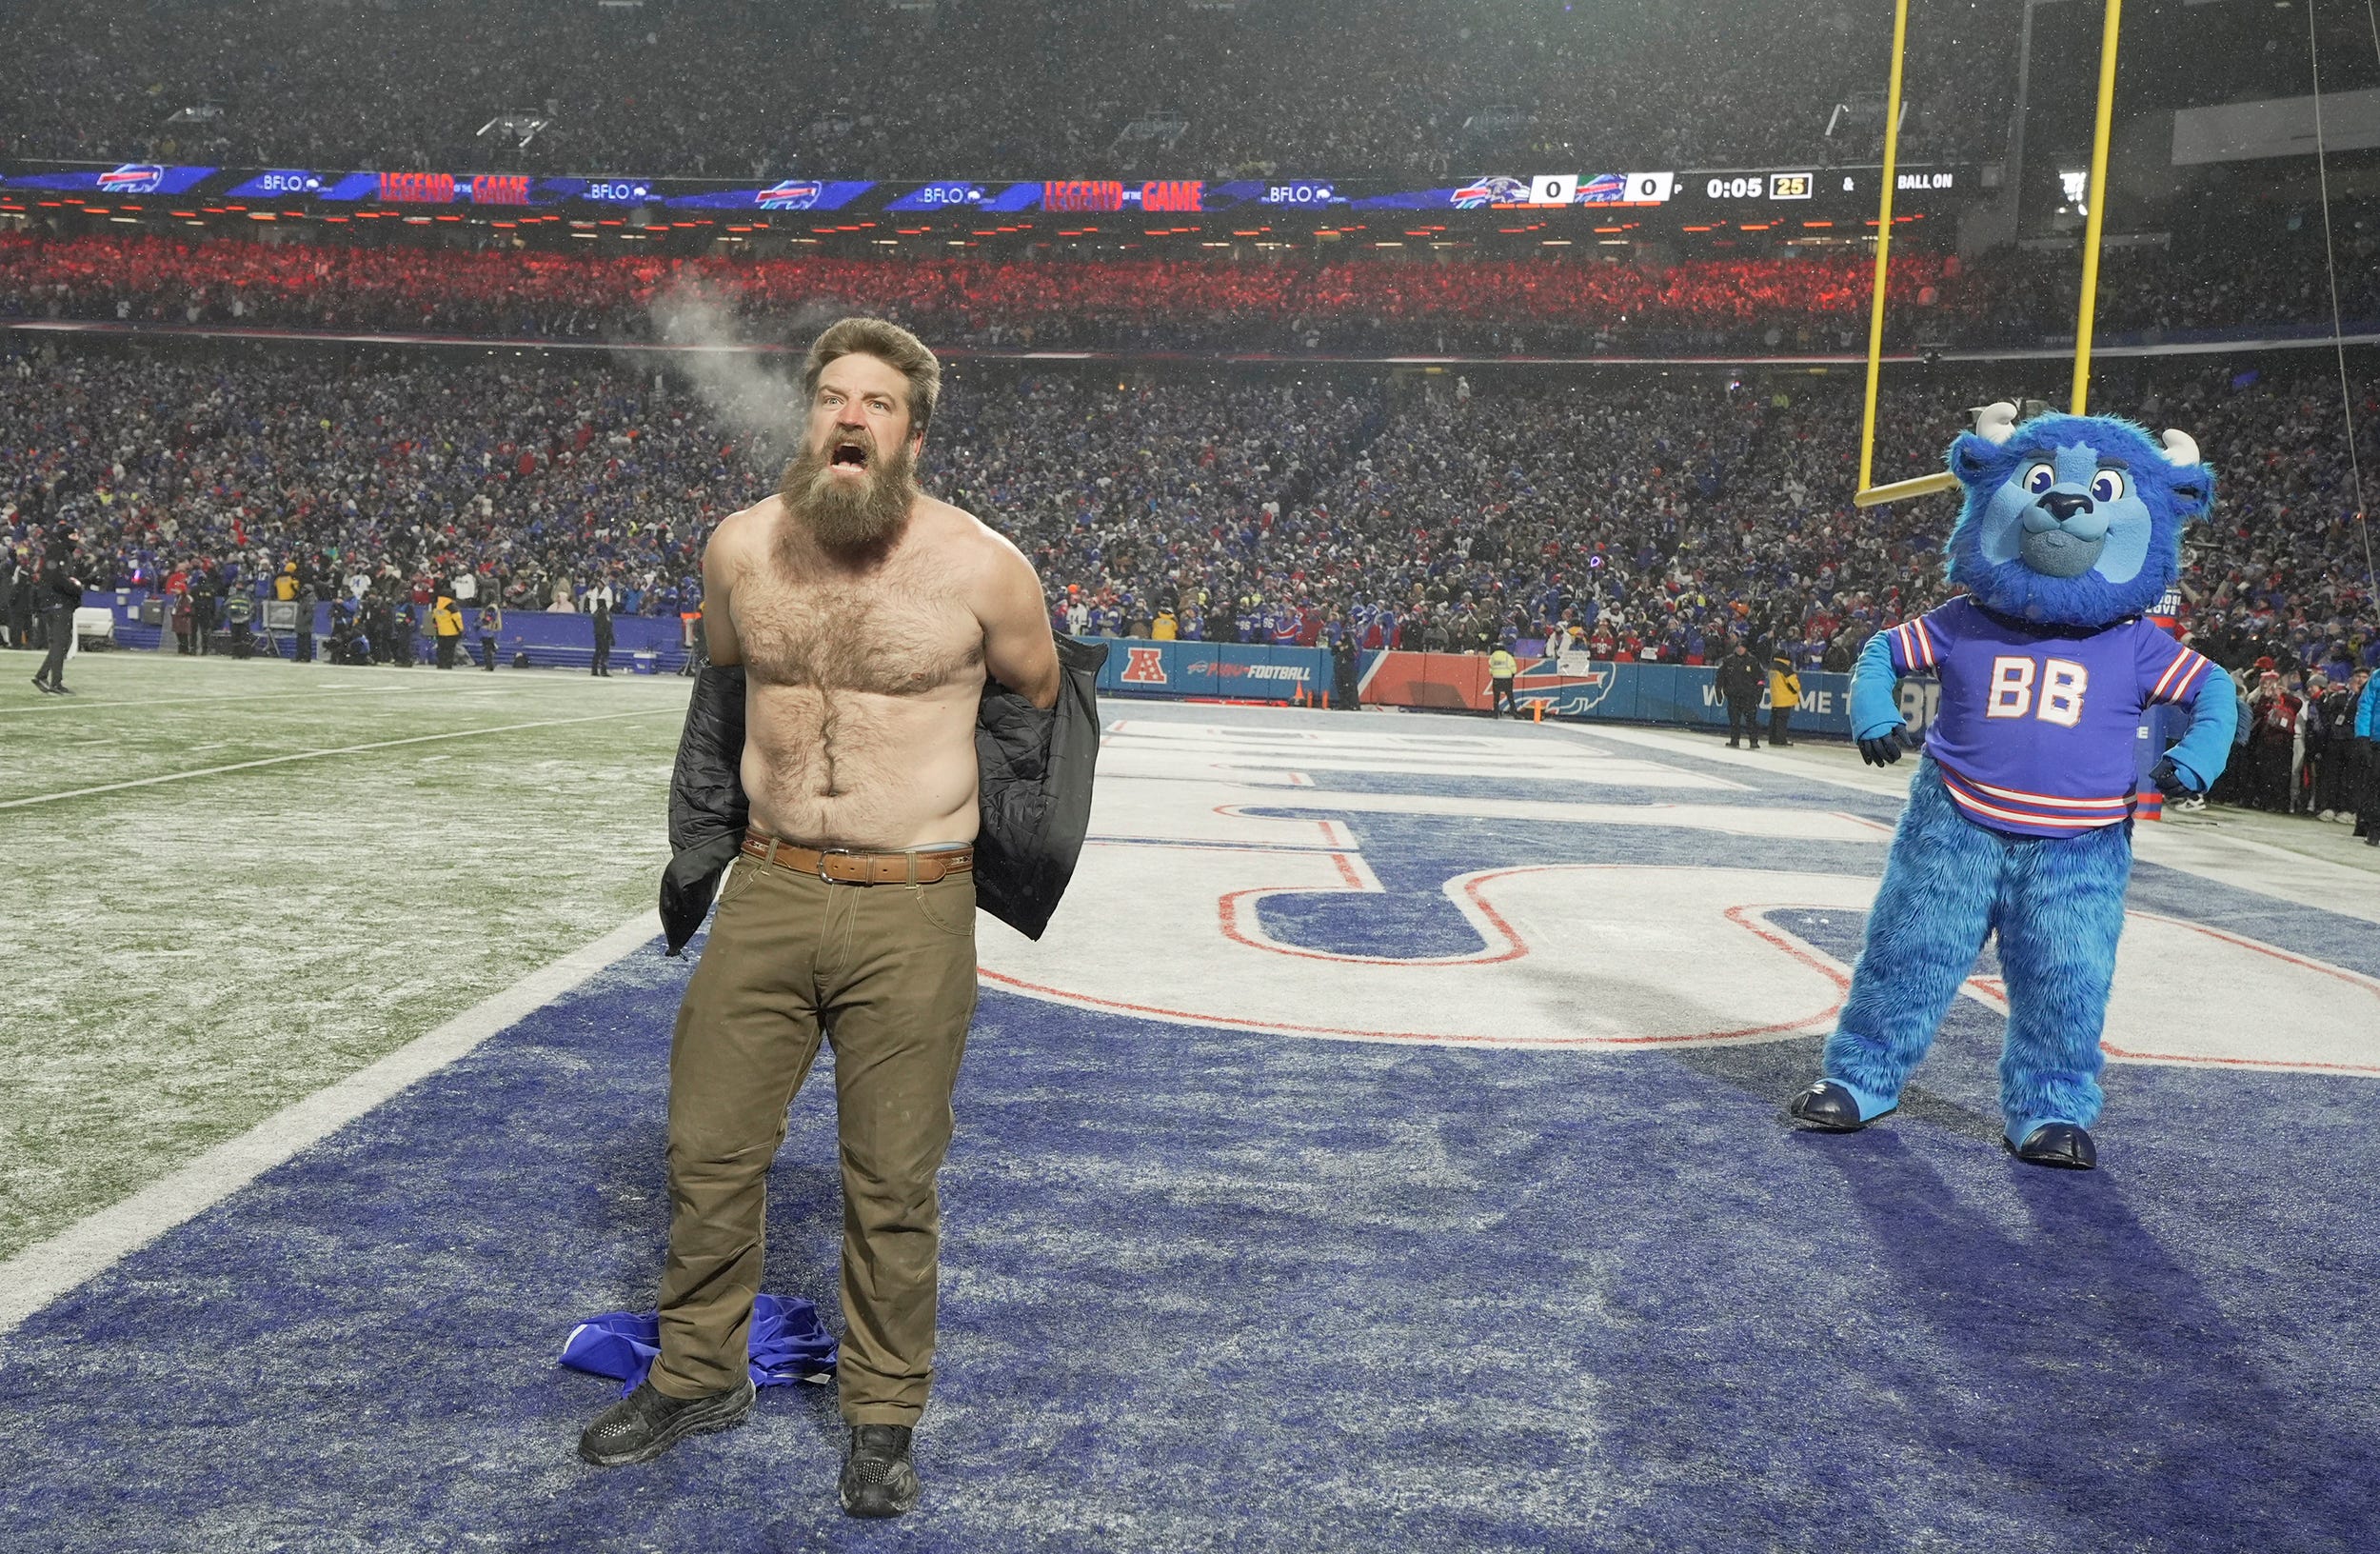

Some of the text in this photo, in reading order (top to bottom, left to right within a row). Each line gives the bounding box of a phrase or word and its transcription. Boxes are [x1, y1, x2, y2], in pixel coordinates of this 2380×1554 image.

[264, 175, 303, 190] BFLO
[381, 172, 454, 201] LEGEND
[473, 175, 529, 205] GAME
[1546, 181, 1561, 198] 0
[1640, 179, 1657, 196] 0
[1707, 178, 1762, 198] 0:05
[1776, 178, 1805, 195] 25
[1897, 174, 1932, 189] BALL
[1933, 173, 1953, 189] ON
[591, 184, 629, 199] BFLO
[923, 188, 963, 203] BFLO
[1045, 181, 1123, 210] LEGEND
[1143, 181, 1202, 211] GAME
[1270, 187, 1312, 202] BFLO
[1247, 665, 1311, 680] FOOTBALL
[1986, 655, 2089, 728] BB
